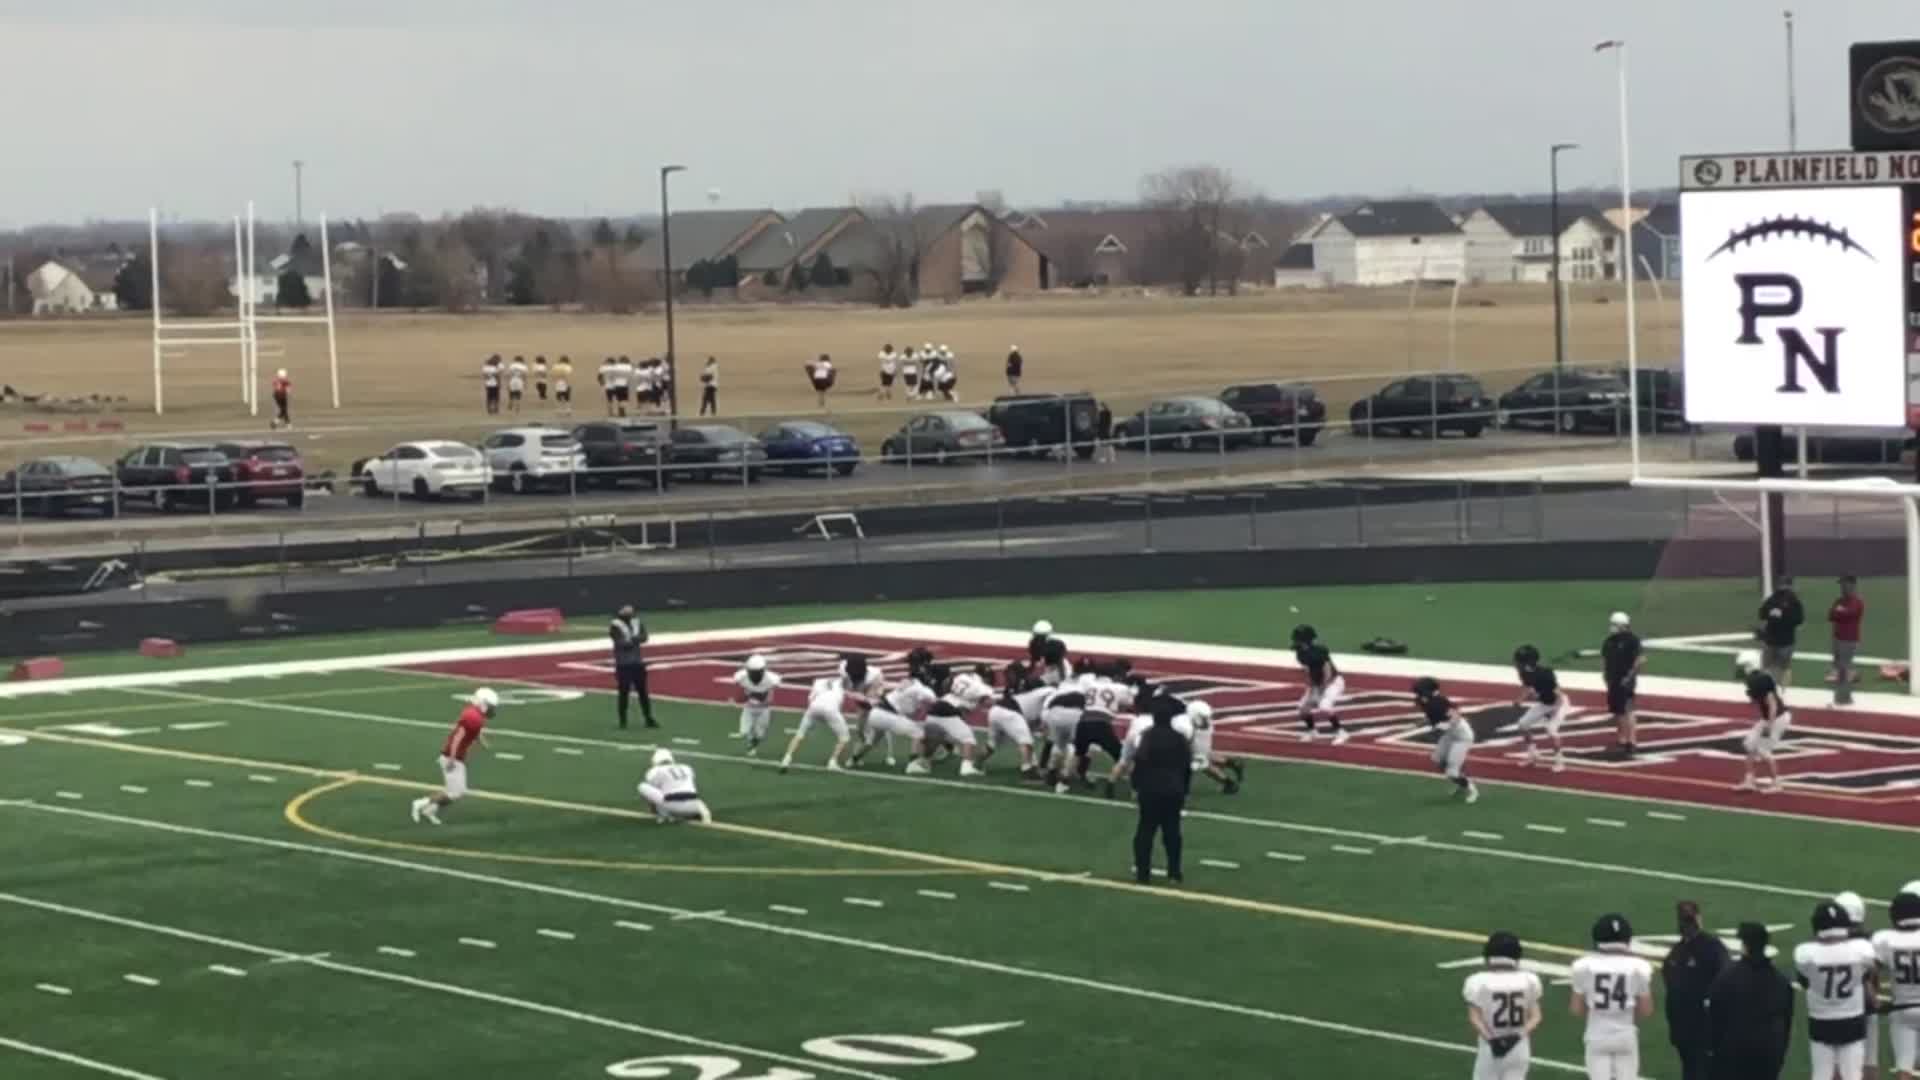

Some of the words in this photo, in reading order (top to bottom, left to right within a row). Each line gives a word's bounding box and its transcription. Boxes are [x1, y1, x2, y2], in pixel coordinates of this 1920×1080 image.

[1734, 155, 1878, 183] PLAINFIELD
[1594, 973, 1627, 1010] 54
[1818, 965, 1853, 999] 72
[1493, 991, 1524, 1028] 26
